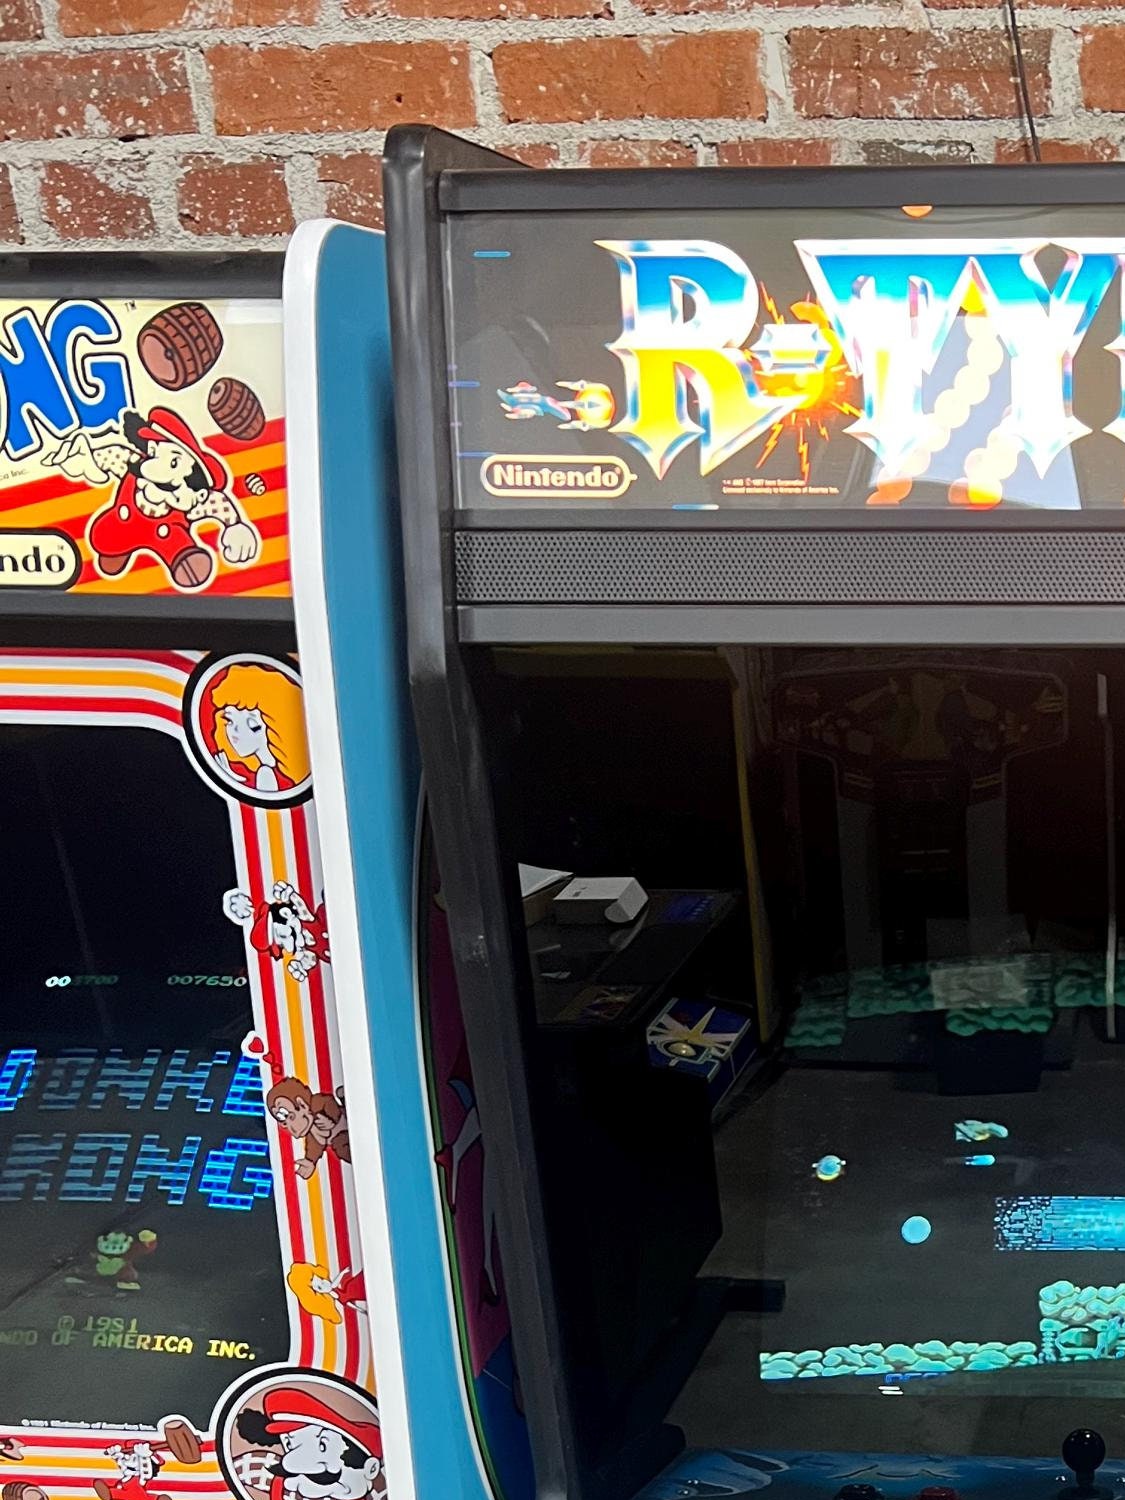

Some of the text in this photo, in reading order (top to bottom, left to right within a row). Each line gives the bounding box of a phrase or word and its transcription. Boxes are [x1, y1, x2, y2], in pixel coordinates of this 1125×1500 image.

[493, 464, 620, 489] Nintendo
[52, 1330, 79, 1346] OF
[93, 1333, 194, 1354] AMERICA
[206, 1340, 256, 1360] INC.
